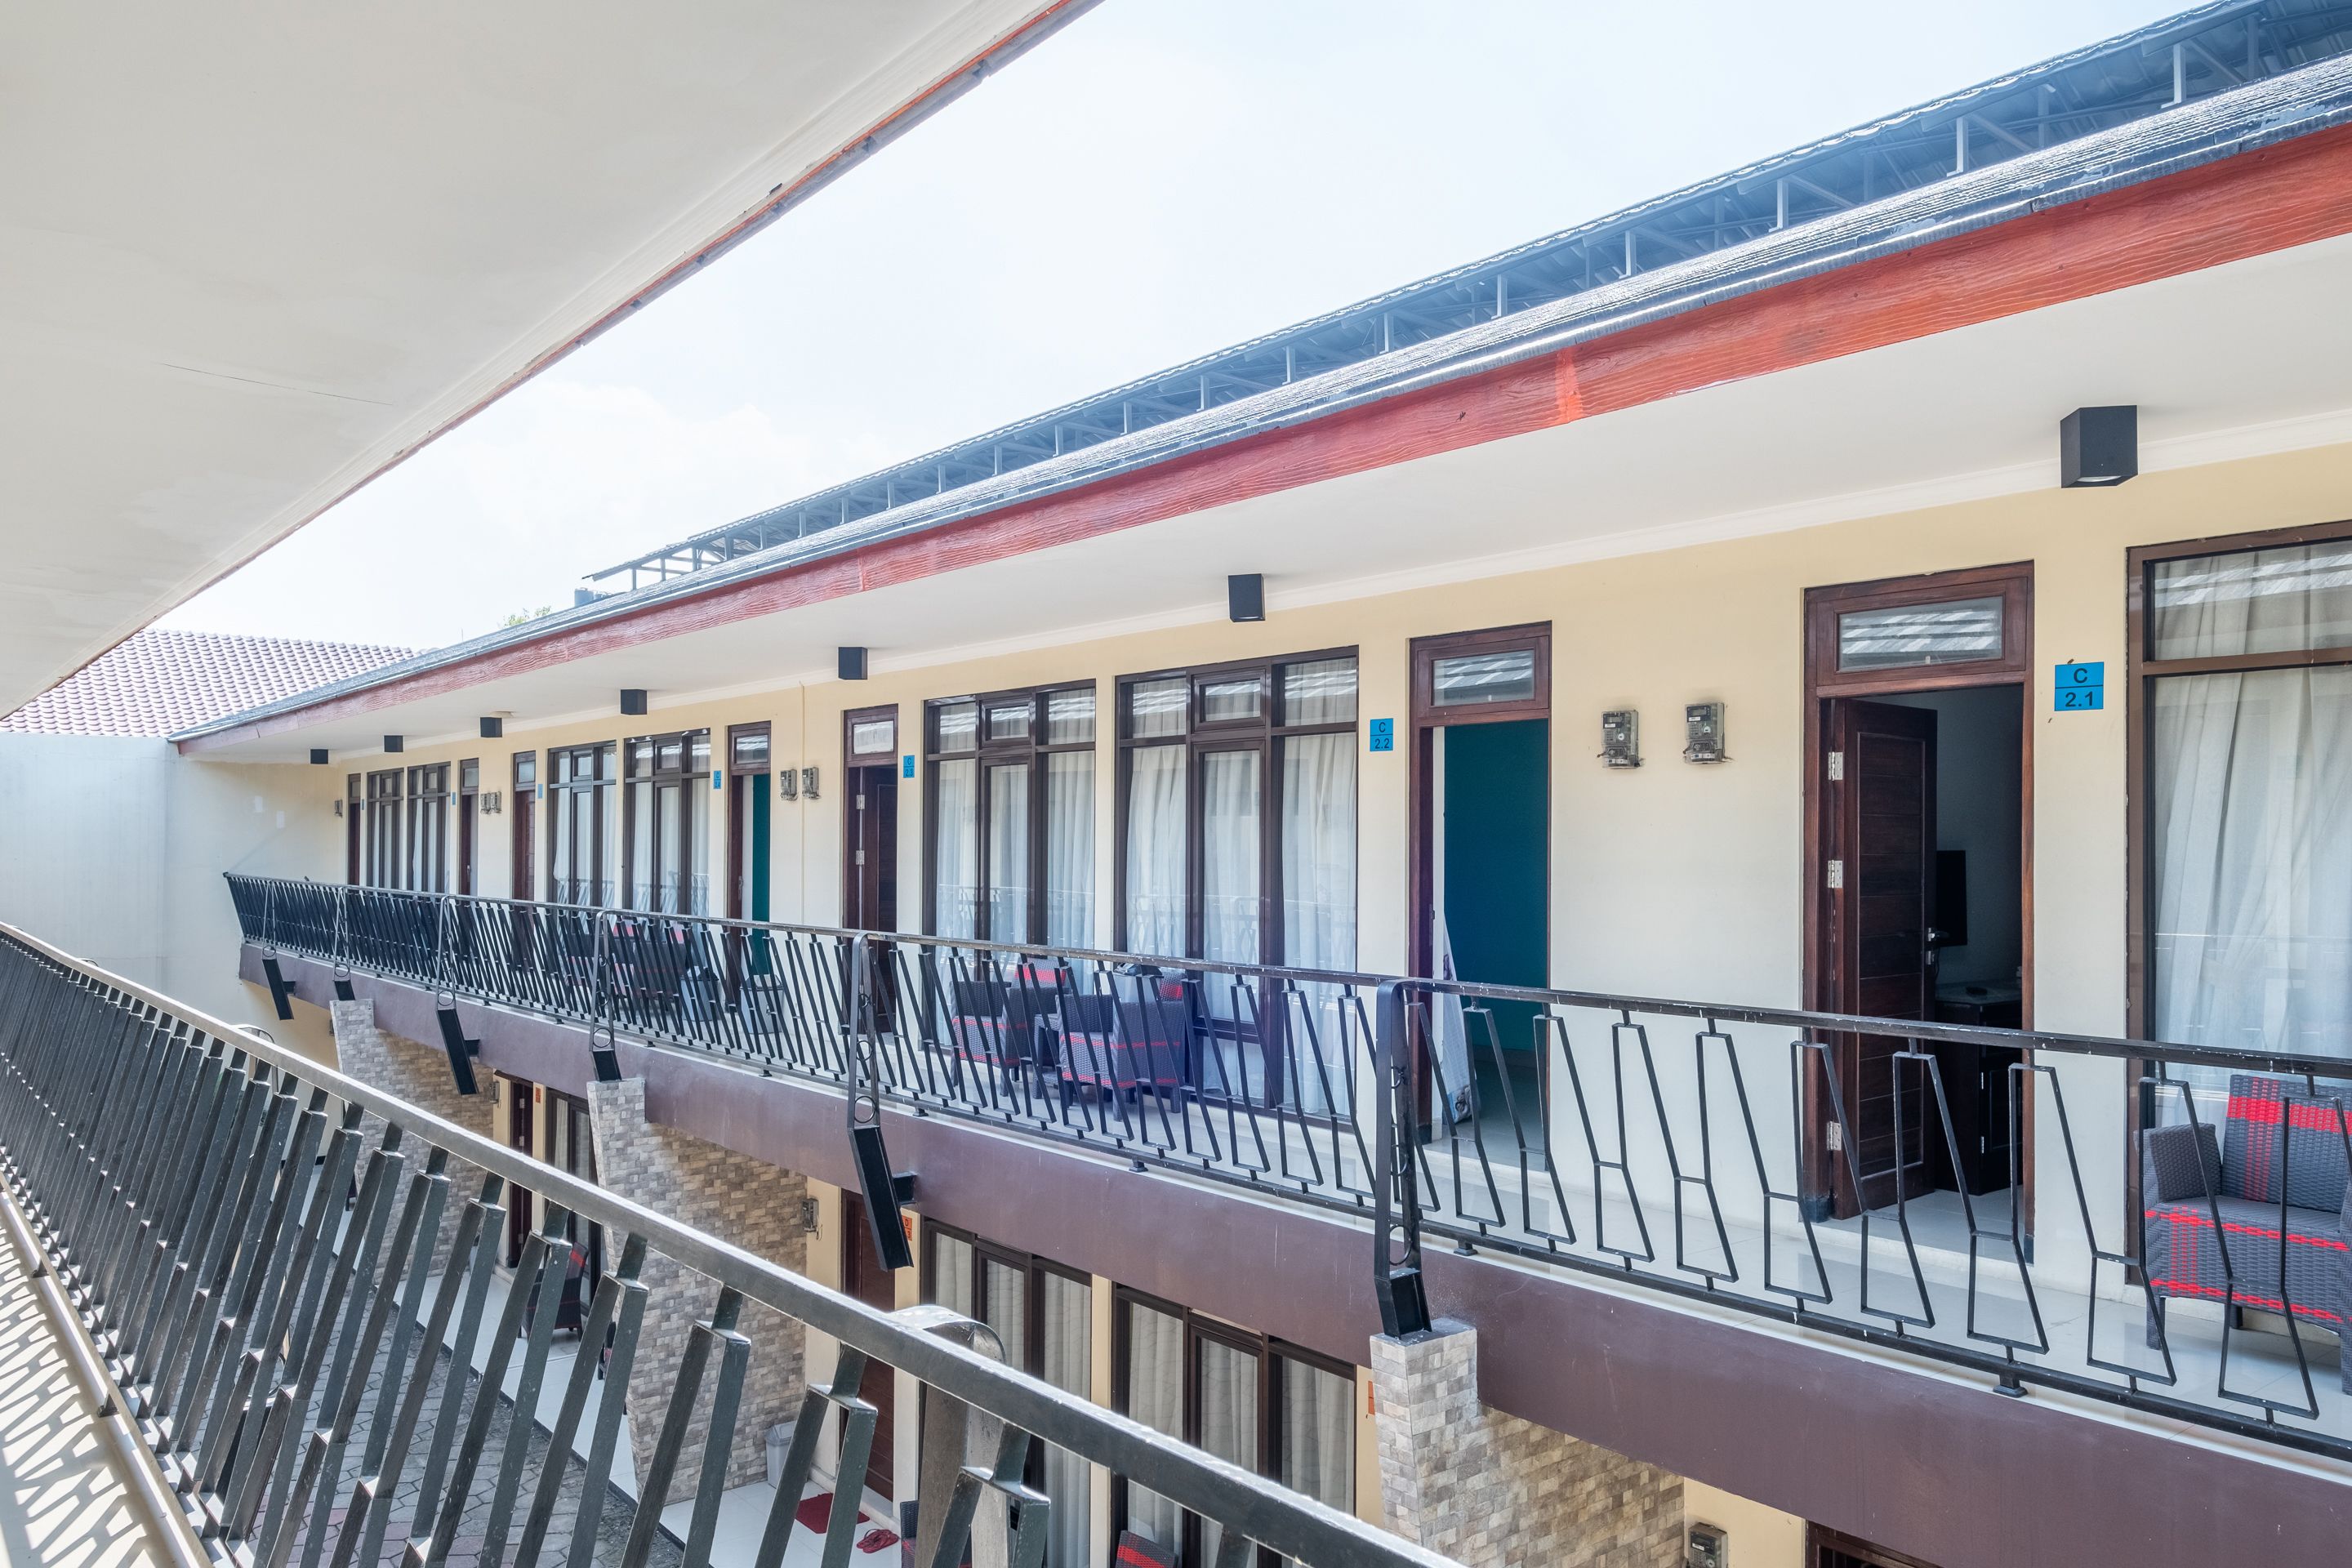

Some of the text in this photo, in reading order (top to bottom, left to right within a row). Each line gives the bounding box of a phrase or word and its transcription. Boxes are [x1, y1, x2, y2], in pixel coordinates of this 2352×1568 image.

[2074, 668, 2087, 684] C
[2065, 691, 2093, 707] 2.1
[1379, 721, 1386, 733] C
[1374, 737, 1389, 749] 2.2
[906, 757, 912, 765] C
